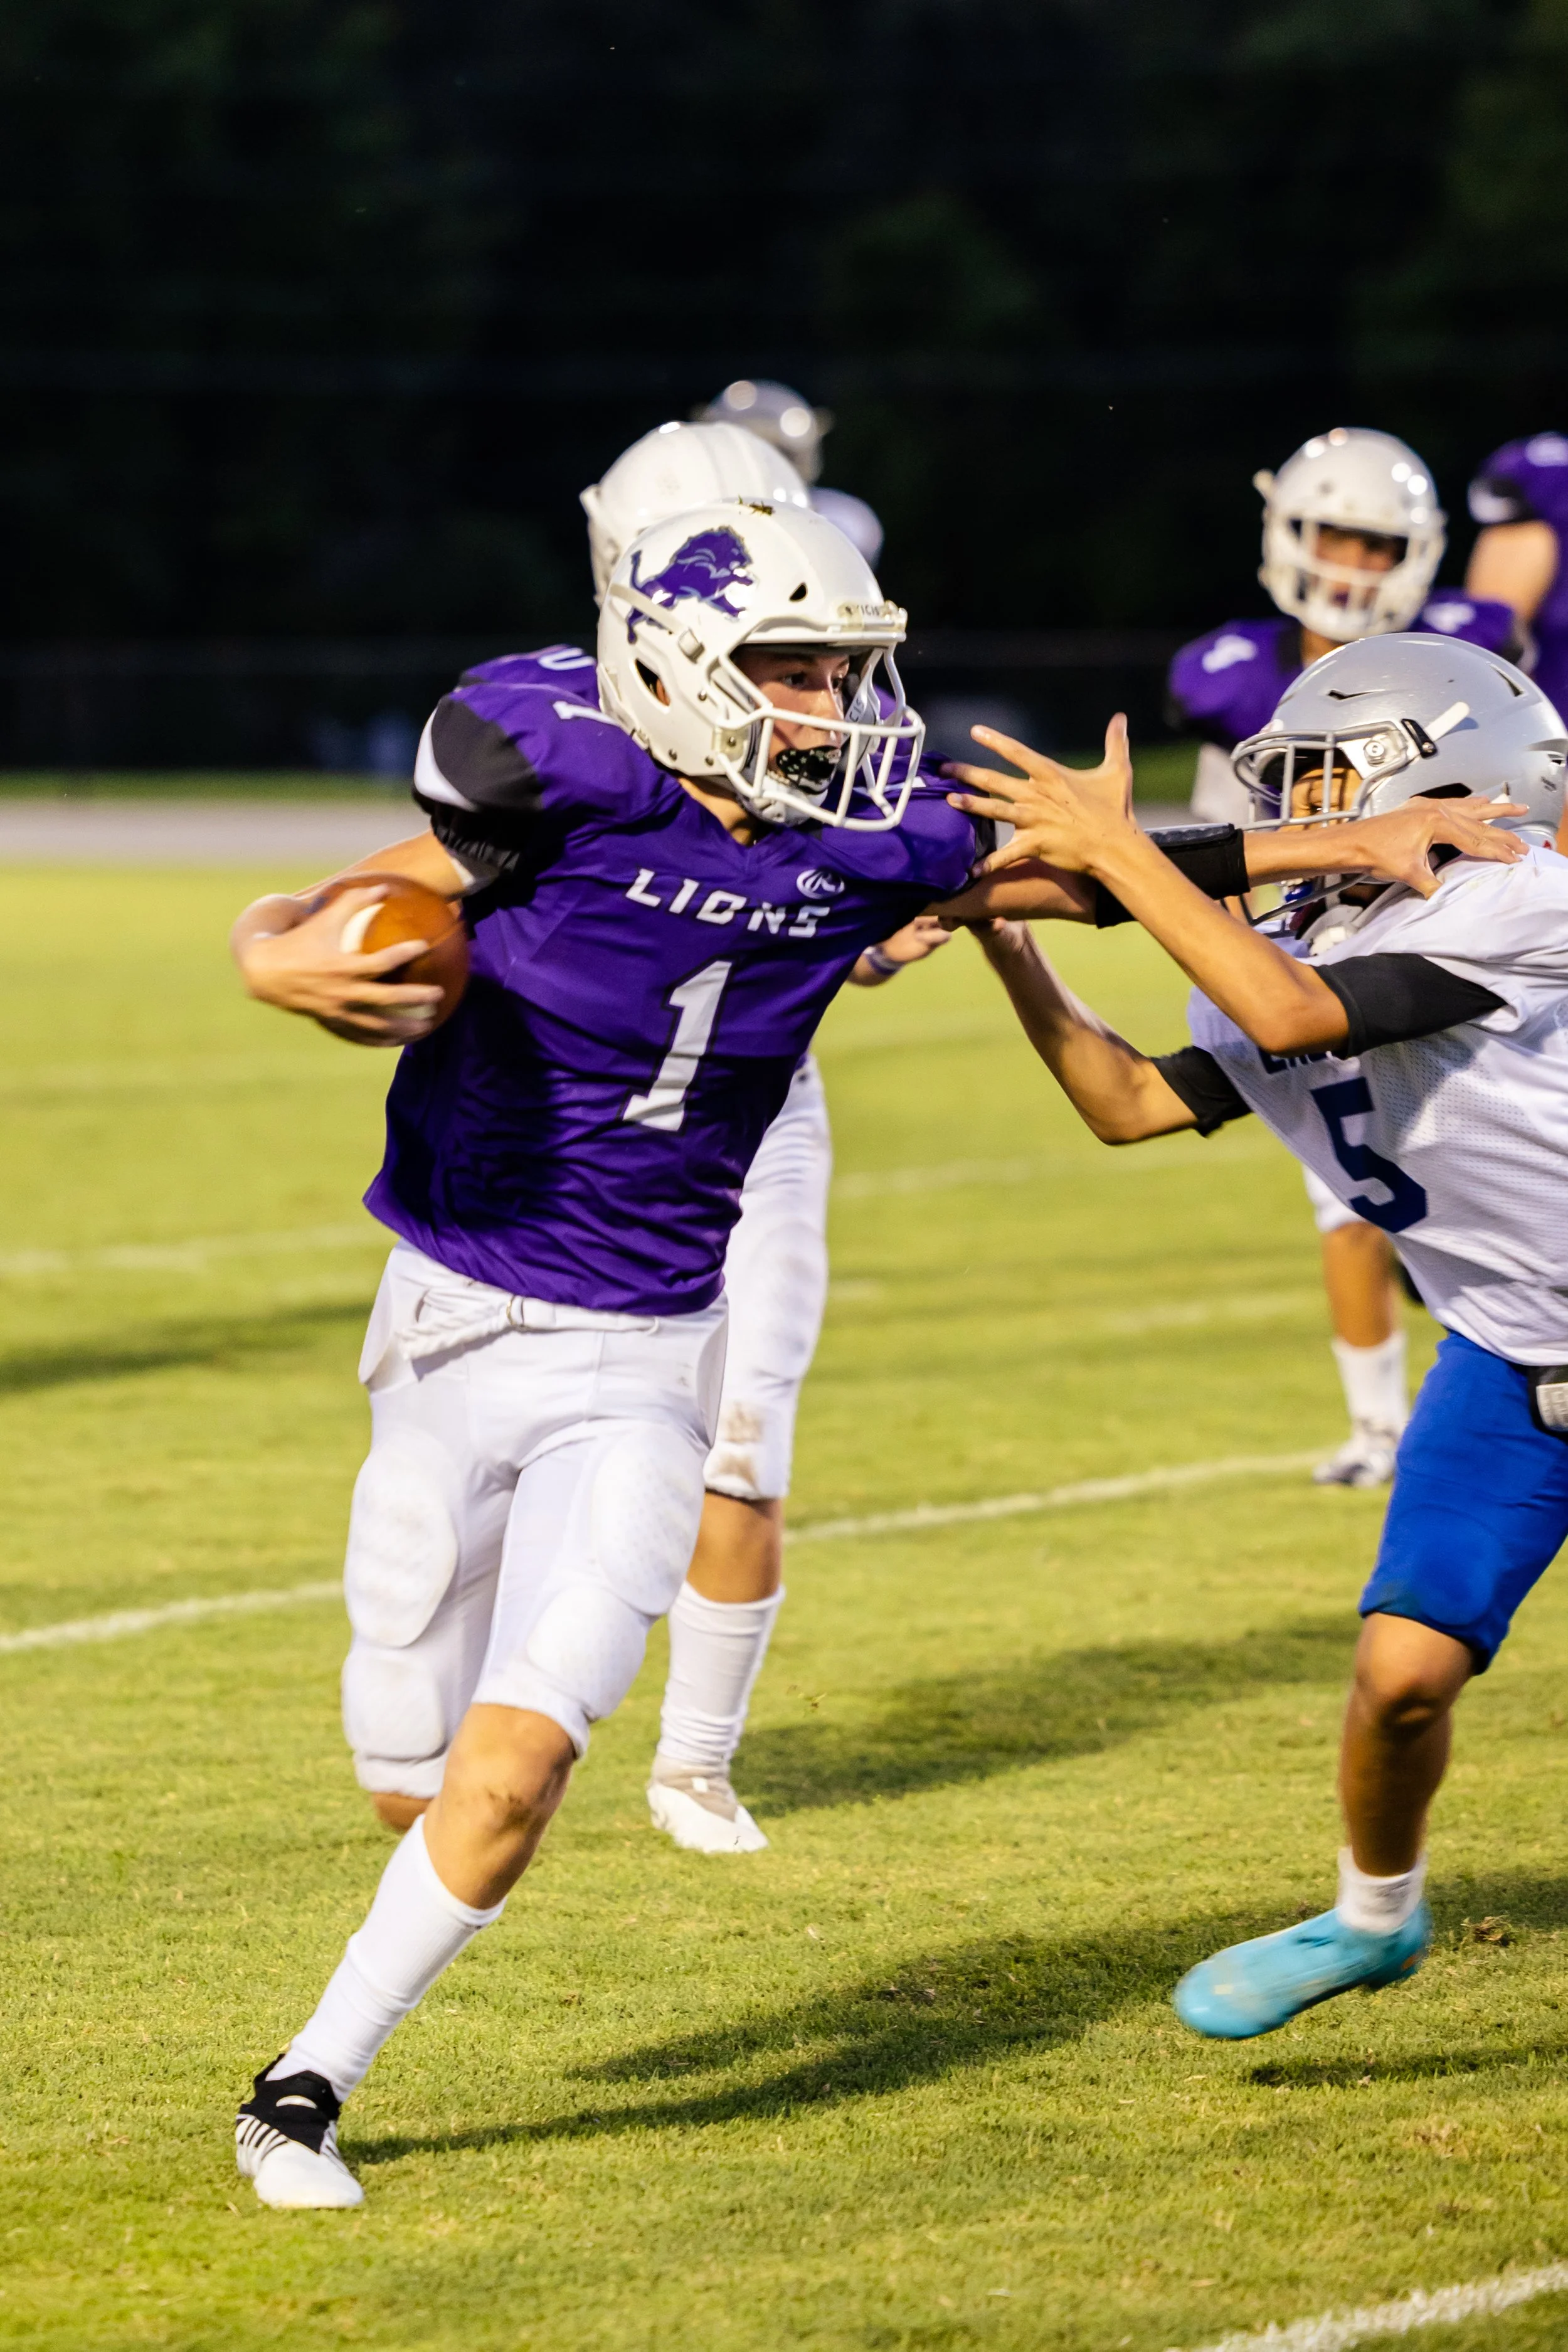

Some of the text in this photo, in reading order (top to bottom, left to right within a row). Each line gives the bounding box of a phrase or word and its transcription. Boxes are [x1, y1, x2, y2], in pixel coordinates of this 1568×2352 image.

[625, 868, 830, 938] LIONS
[622, 959, 733, 1132] 1
[1311, 1076, 1429, 1234] 5
